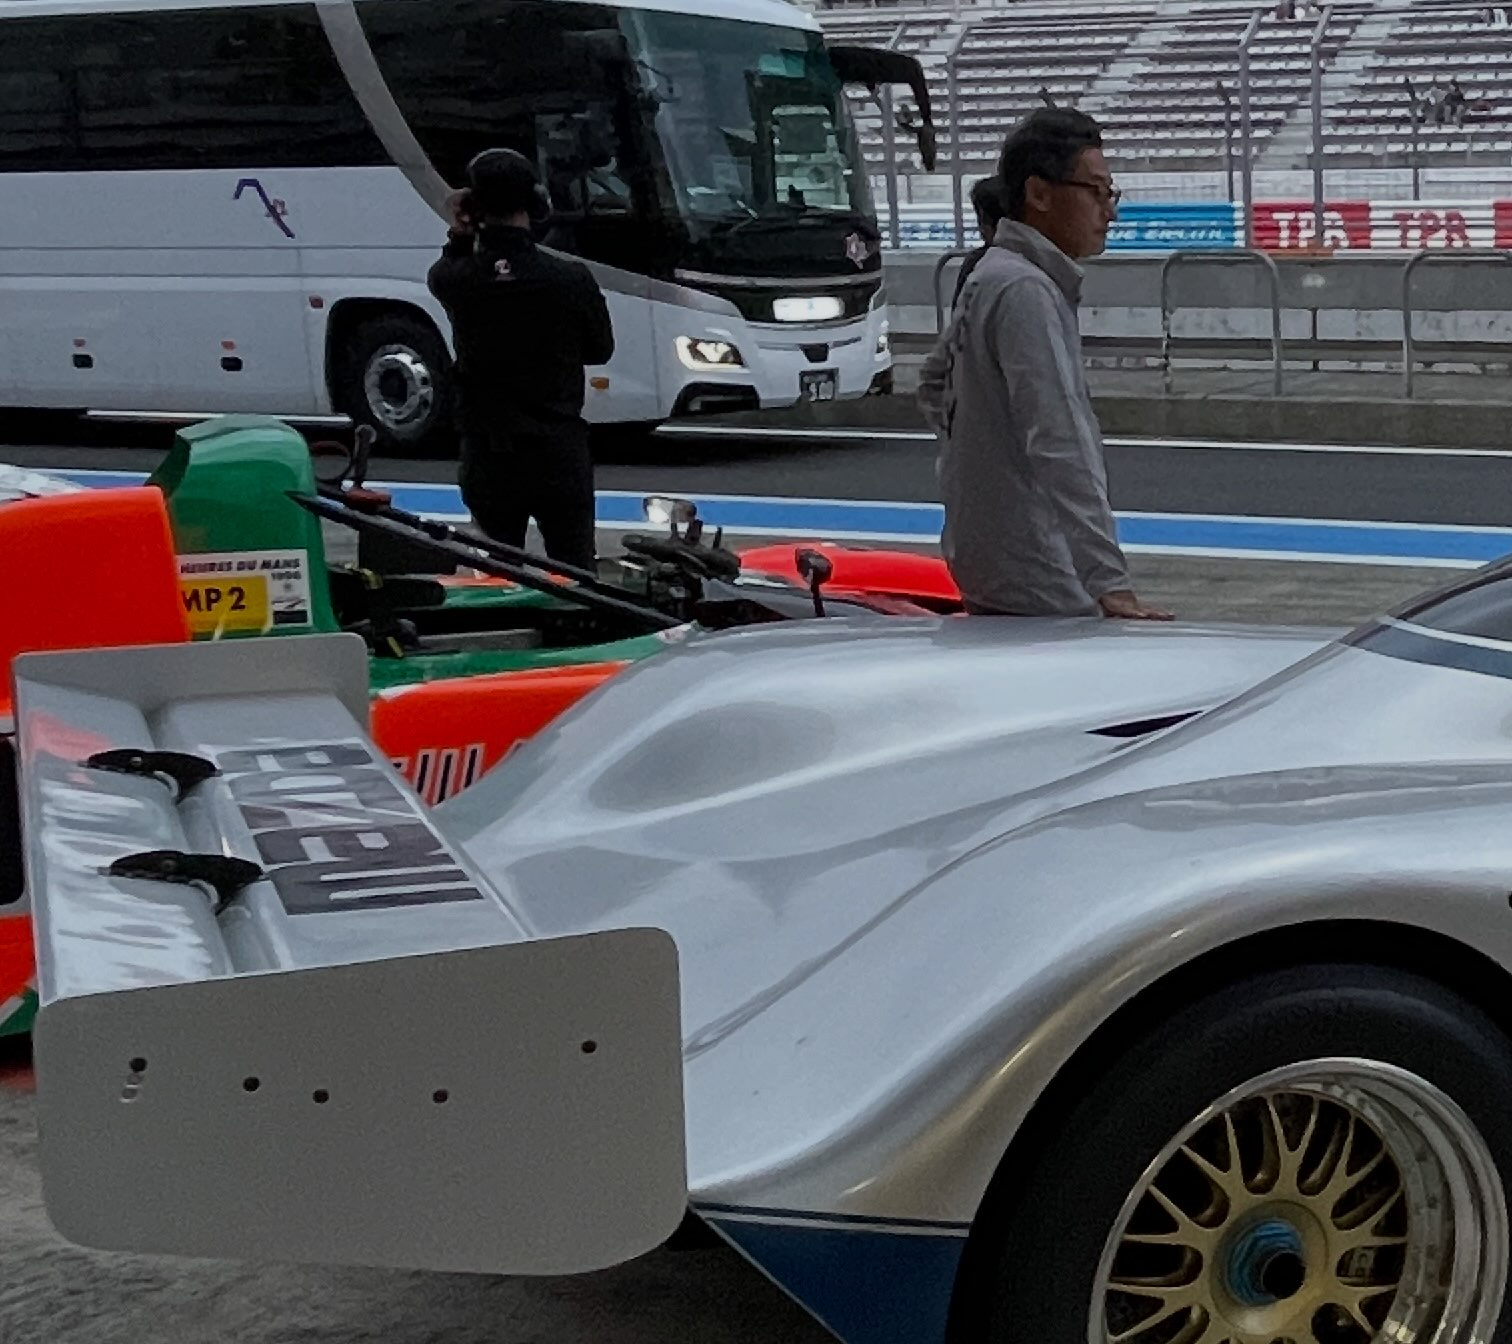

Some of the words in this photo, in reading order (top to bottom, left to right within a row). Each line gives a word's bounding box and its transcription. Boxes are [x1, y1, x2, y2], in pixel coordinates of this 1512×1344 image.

[1272, 211, 1350, 248] TPR
[1392, 209, 1472, 248] TPR
[228, 586, 246, 612] 2
